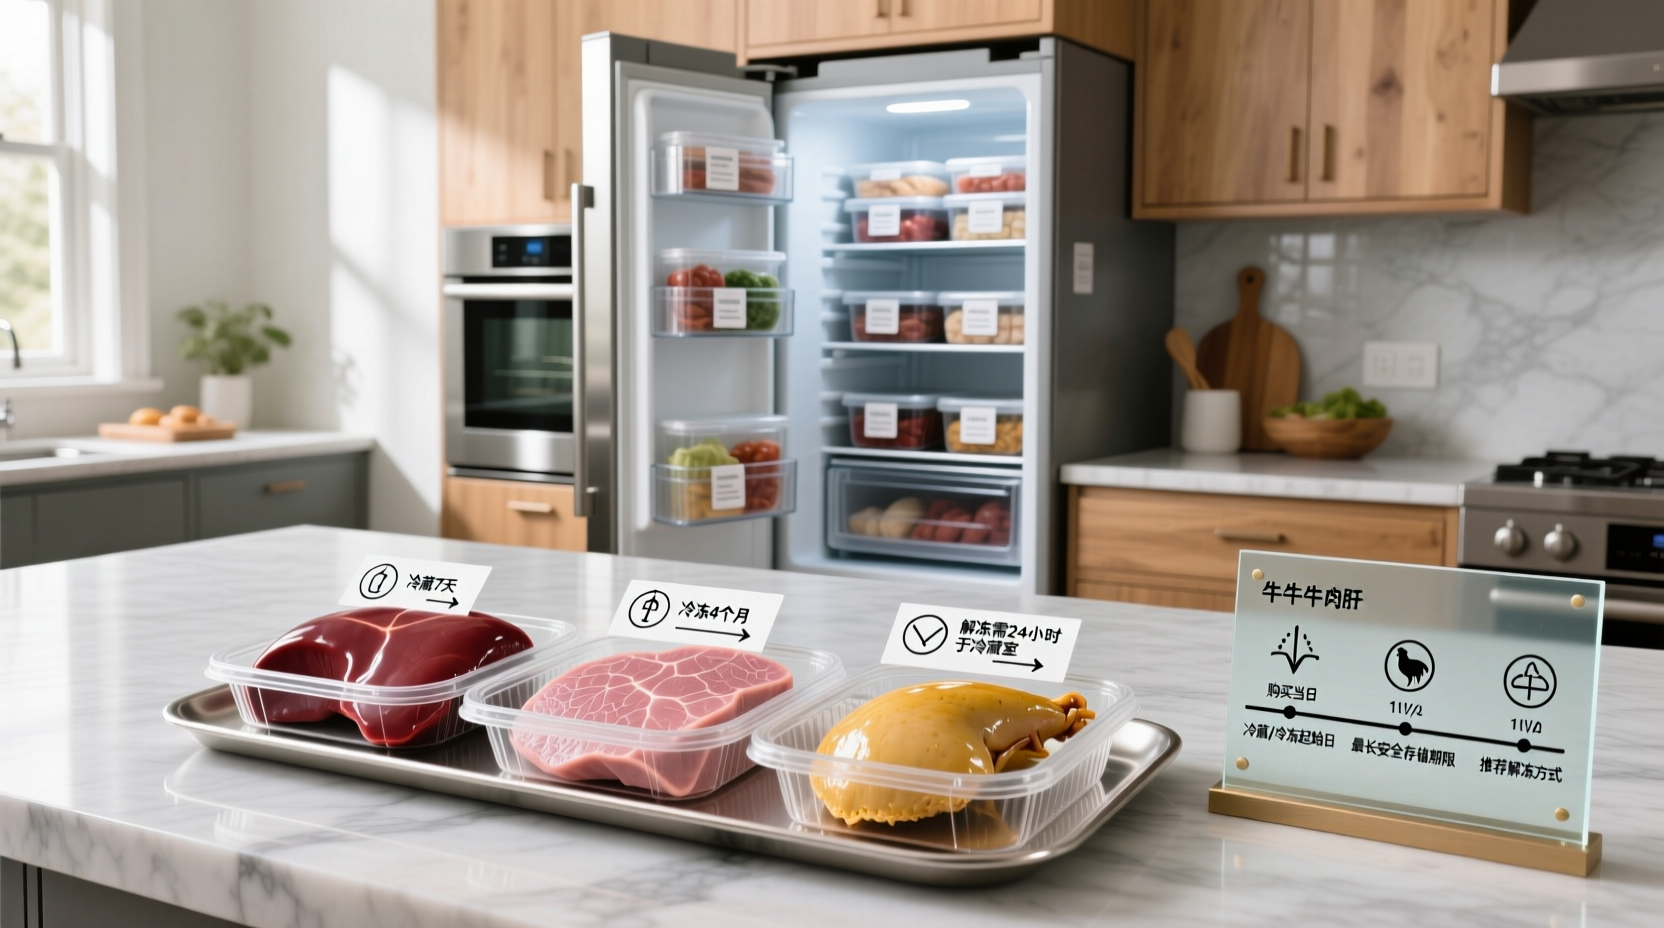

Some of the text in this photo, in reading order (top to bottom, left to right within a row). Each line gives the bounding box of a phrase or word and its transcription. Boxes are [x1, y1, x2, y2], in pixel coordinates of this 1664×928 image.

[406, 573, 458, 593] 冷藏7天
[678, 600, 750, 625] 冷冻4个月
[959, 618, 1063, 644] 解冻需24小时
[1266, 682, 1317, 702] 购买当日
[1479, 756, 1563, 783] 推荐解冻方式
